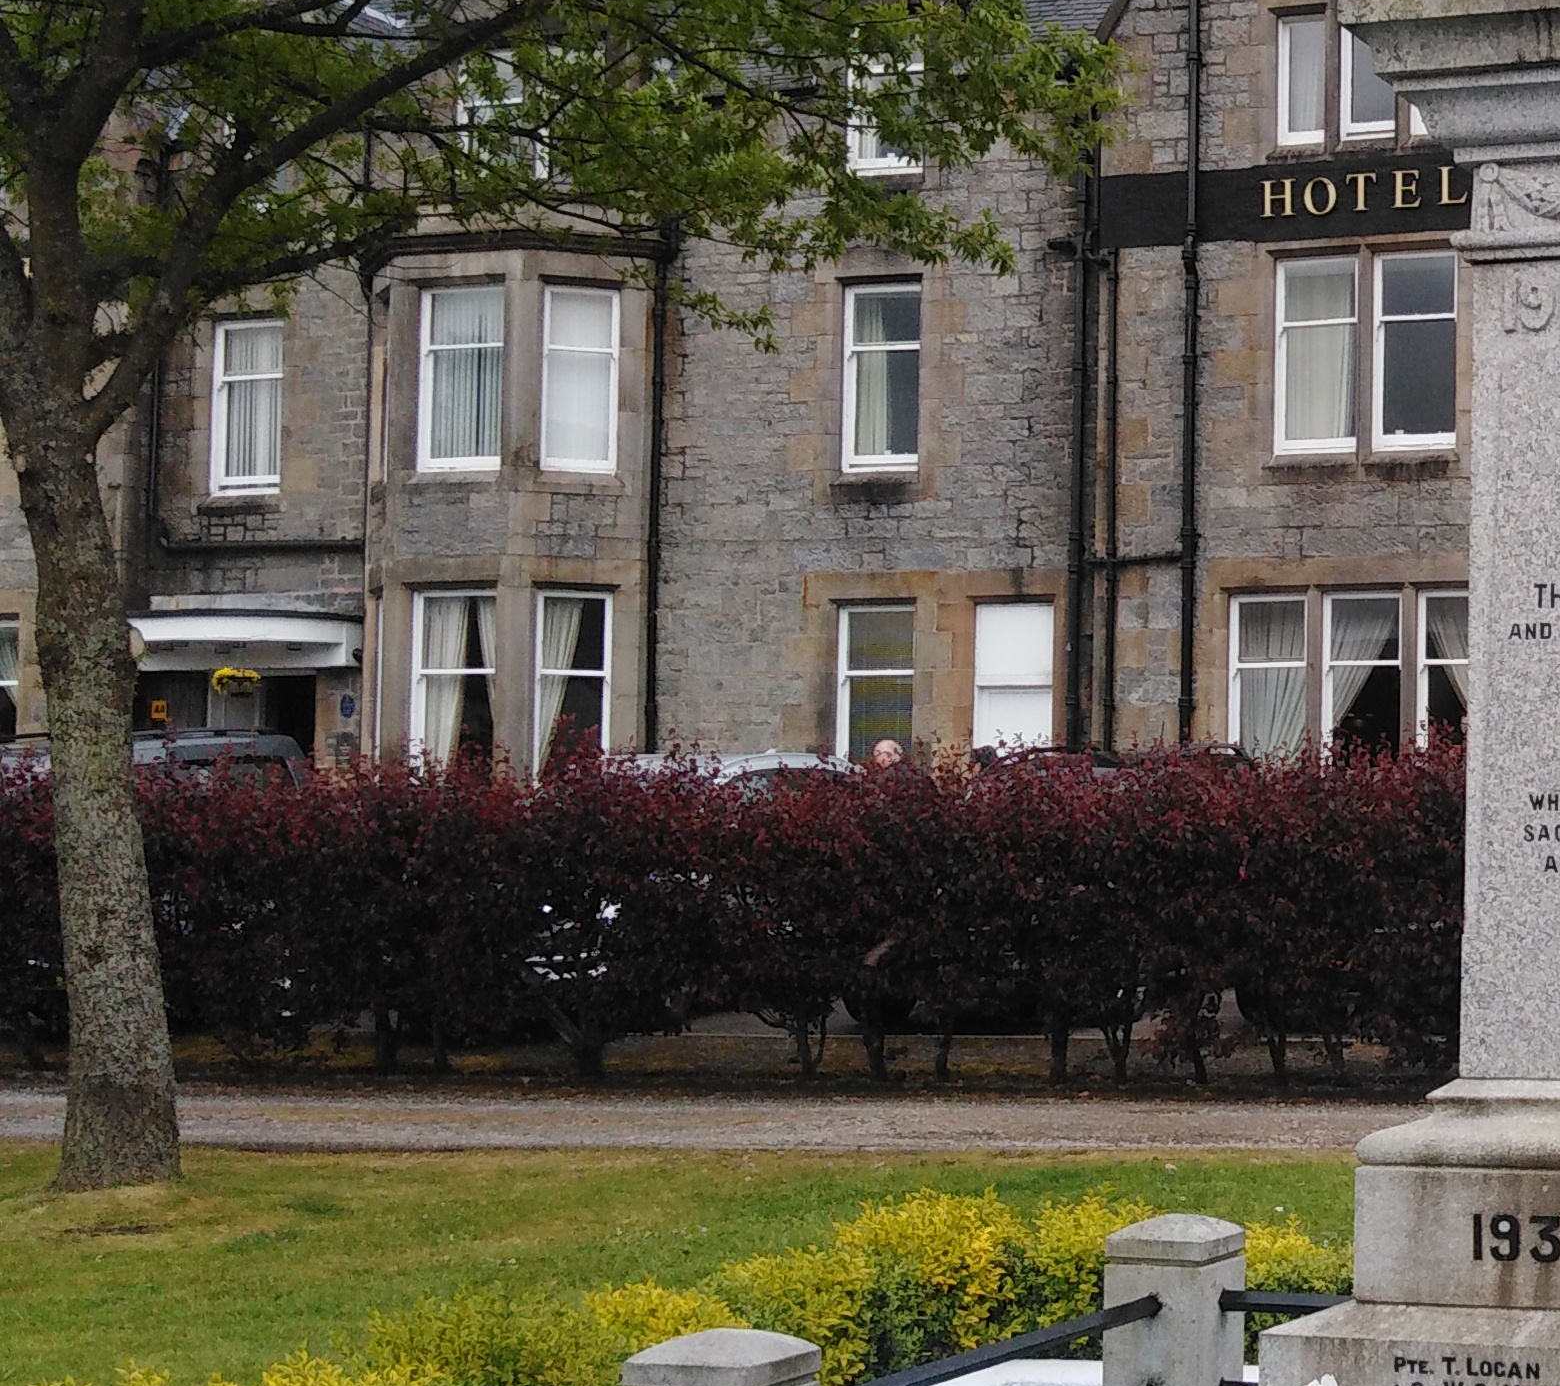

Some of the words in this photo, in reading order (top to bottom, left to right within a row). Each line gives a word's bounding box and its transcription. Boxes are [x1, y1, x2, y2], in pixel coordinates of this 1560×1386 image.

[1260, 166, 1468, 218] HOTEL
[1508, 622, 1552, 639] AND
[1442, 1356, 1460, 1376] T.
